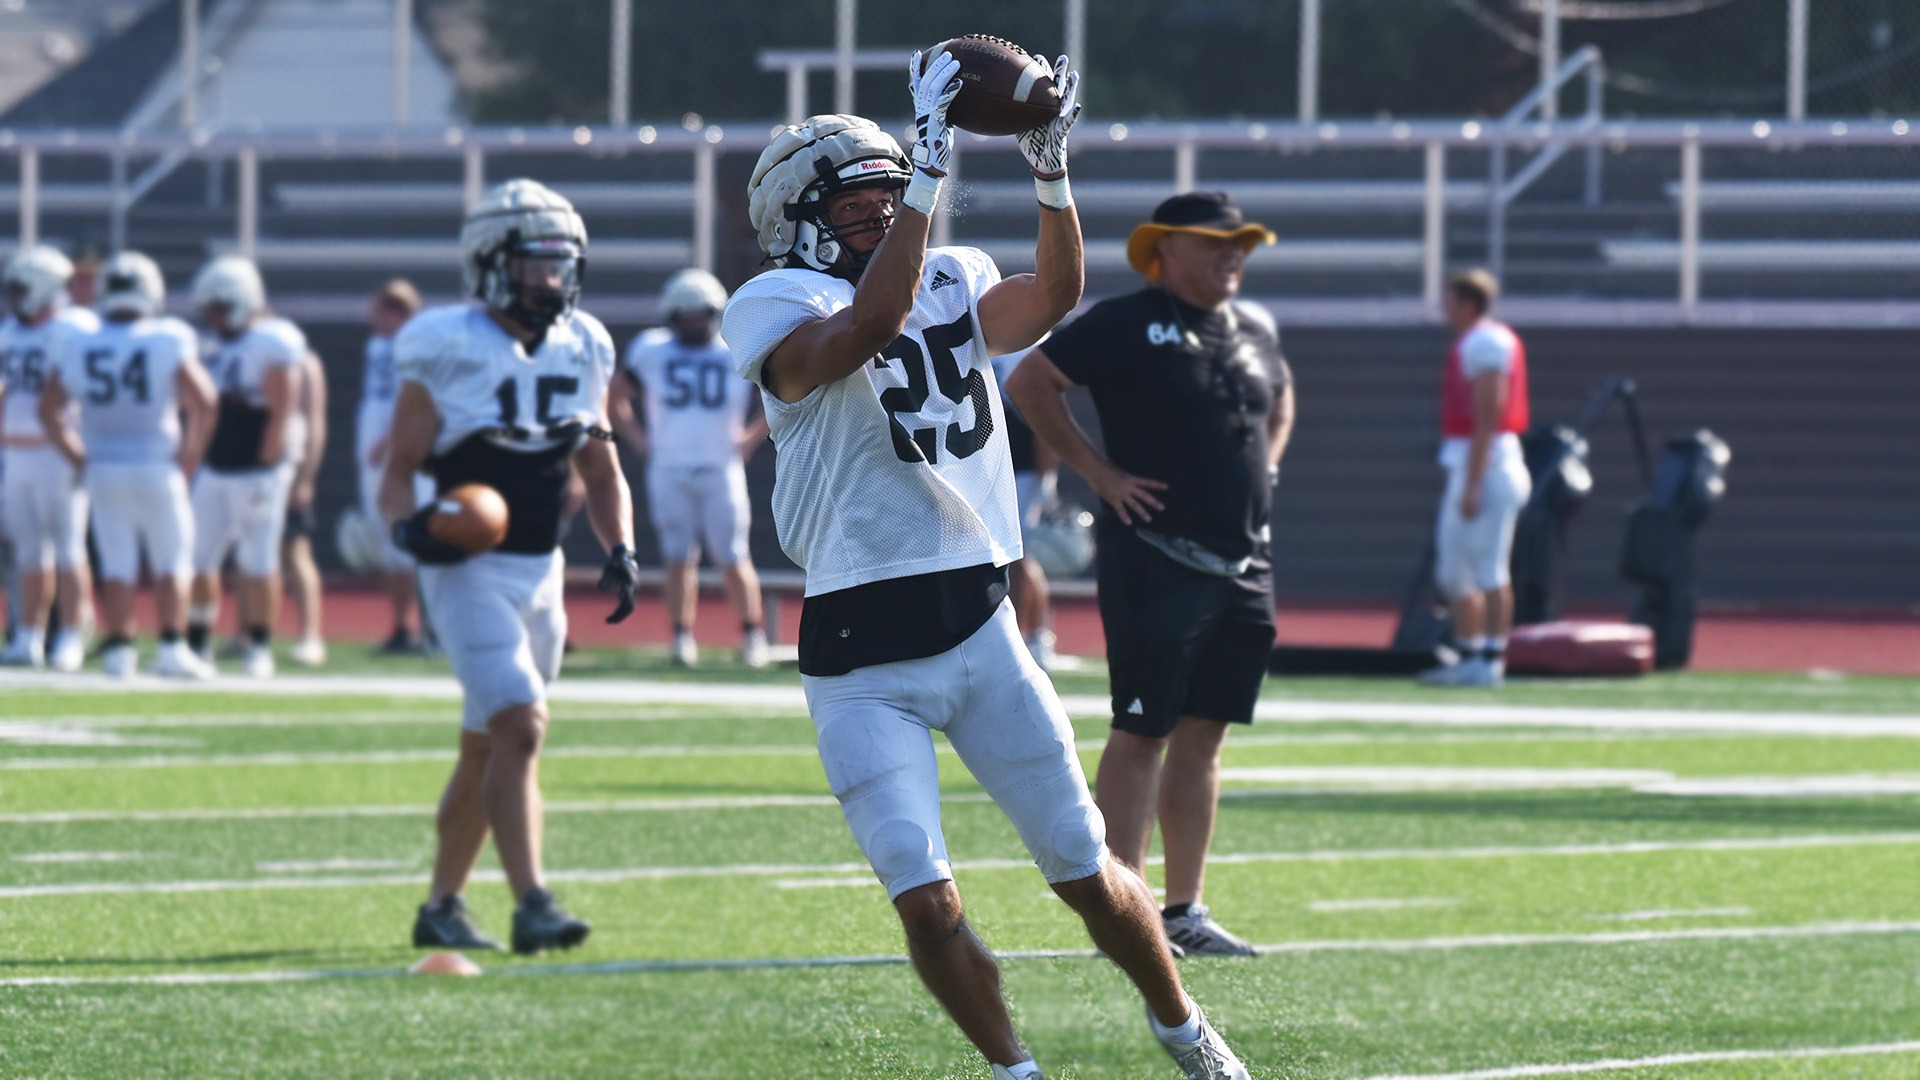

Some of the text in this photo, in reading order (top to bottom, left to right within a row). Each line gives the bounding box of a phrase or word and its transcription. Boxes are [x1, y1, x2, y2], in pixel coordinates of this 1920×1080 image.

[960, 41, 1009, 62] Wilson
[930, 278, 959, 291] adidas
[1147, 322, 1181, 345] 64
[84, 349, 149, 404] 54
[666, 357, 727, 409] 50
[874, 311, 994, 465] 25
